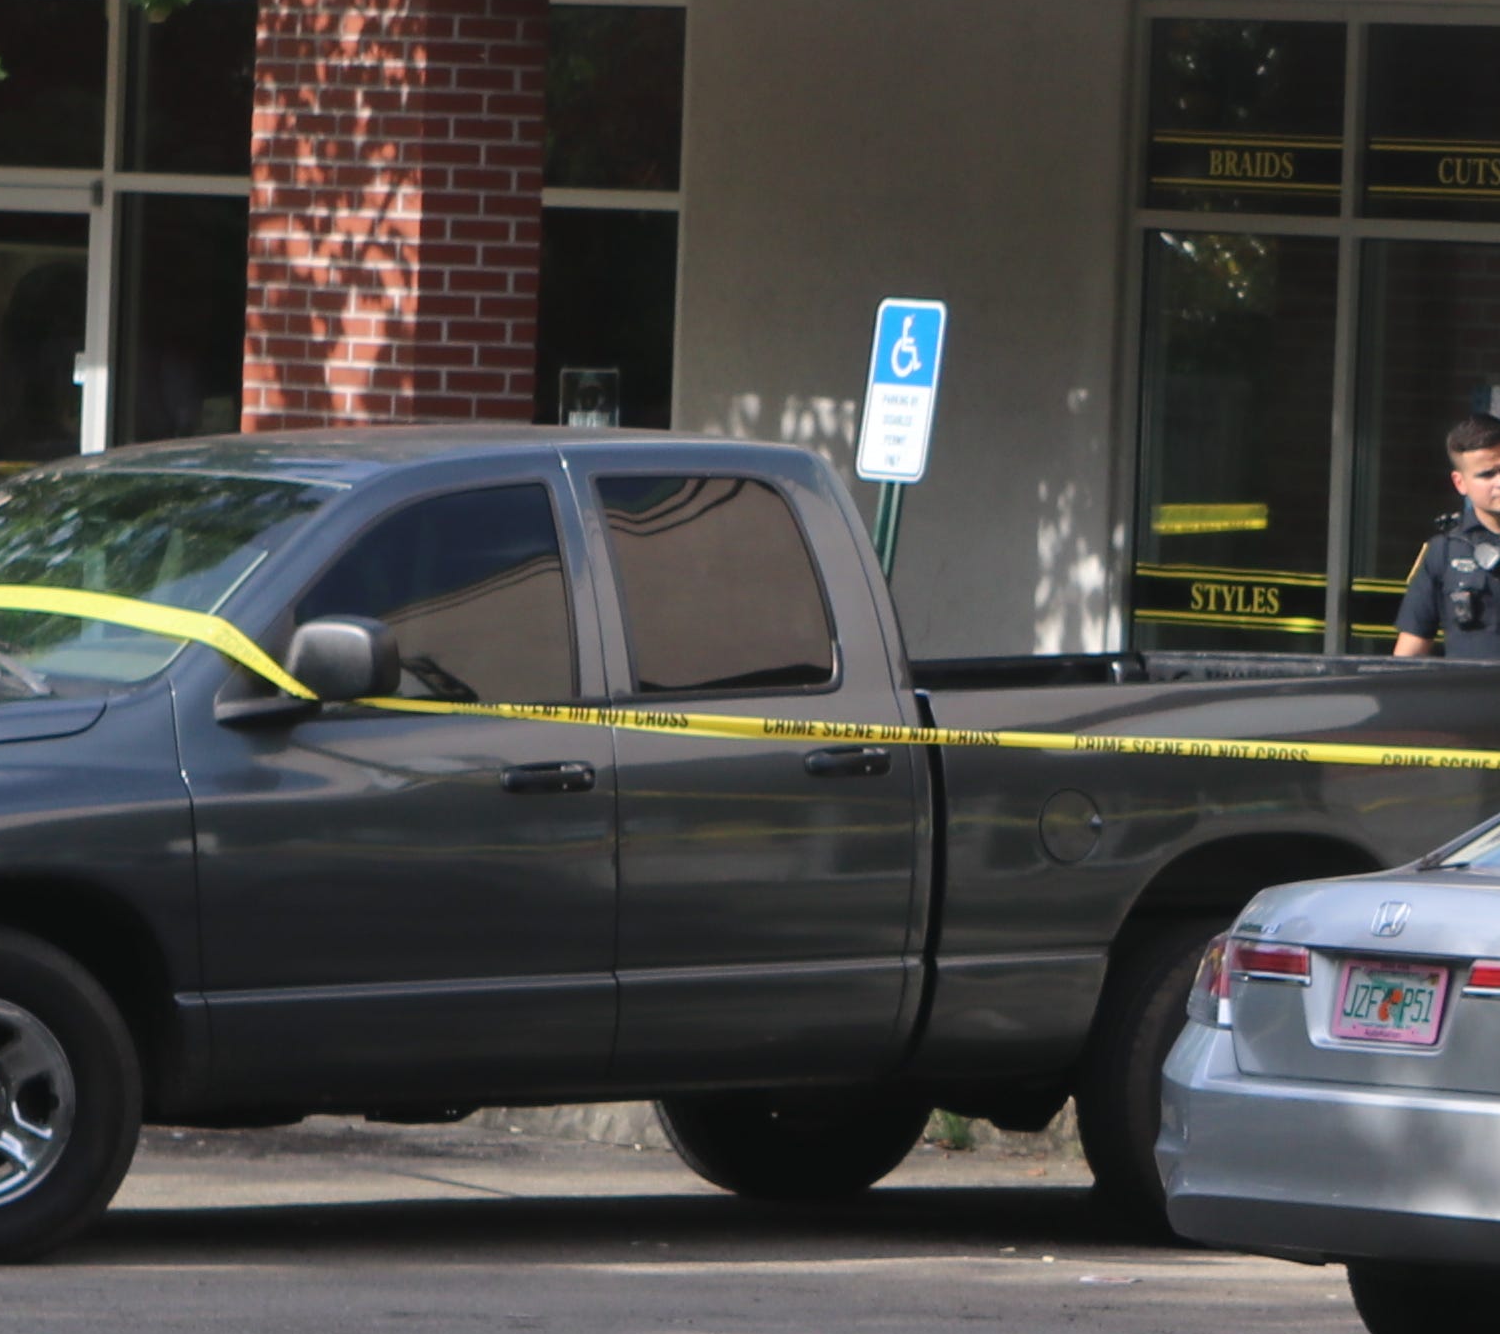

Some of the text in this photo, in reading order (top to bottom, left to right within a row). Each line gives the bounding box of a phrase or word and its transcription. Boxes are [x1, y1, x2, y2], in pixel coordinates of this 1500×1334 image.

[1209, 149, 1295, 180] BRAIDS
[1190, 581, 1281, 615] STYLES
[634, 711, 690, 729] CROSS
[762, 718, 816, 736] CRIME
[822, 721, 875, 739] SCENE
[1074, 735, 1125, 753] CRIME
[1132, 738, 1184, 756] SCENE
[1218, 743, 1250, 759] NOT
[1255, 745, 1310, 762] CROSS
[1342, 983, 1436, 1023] JZF P51
